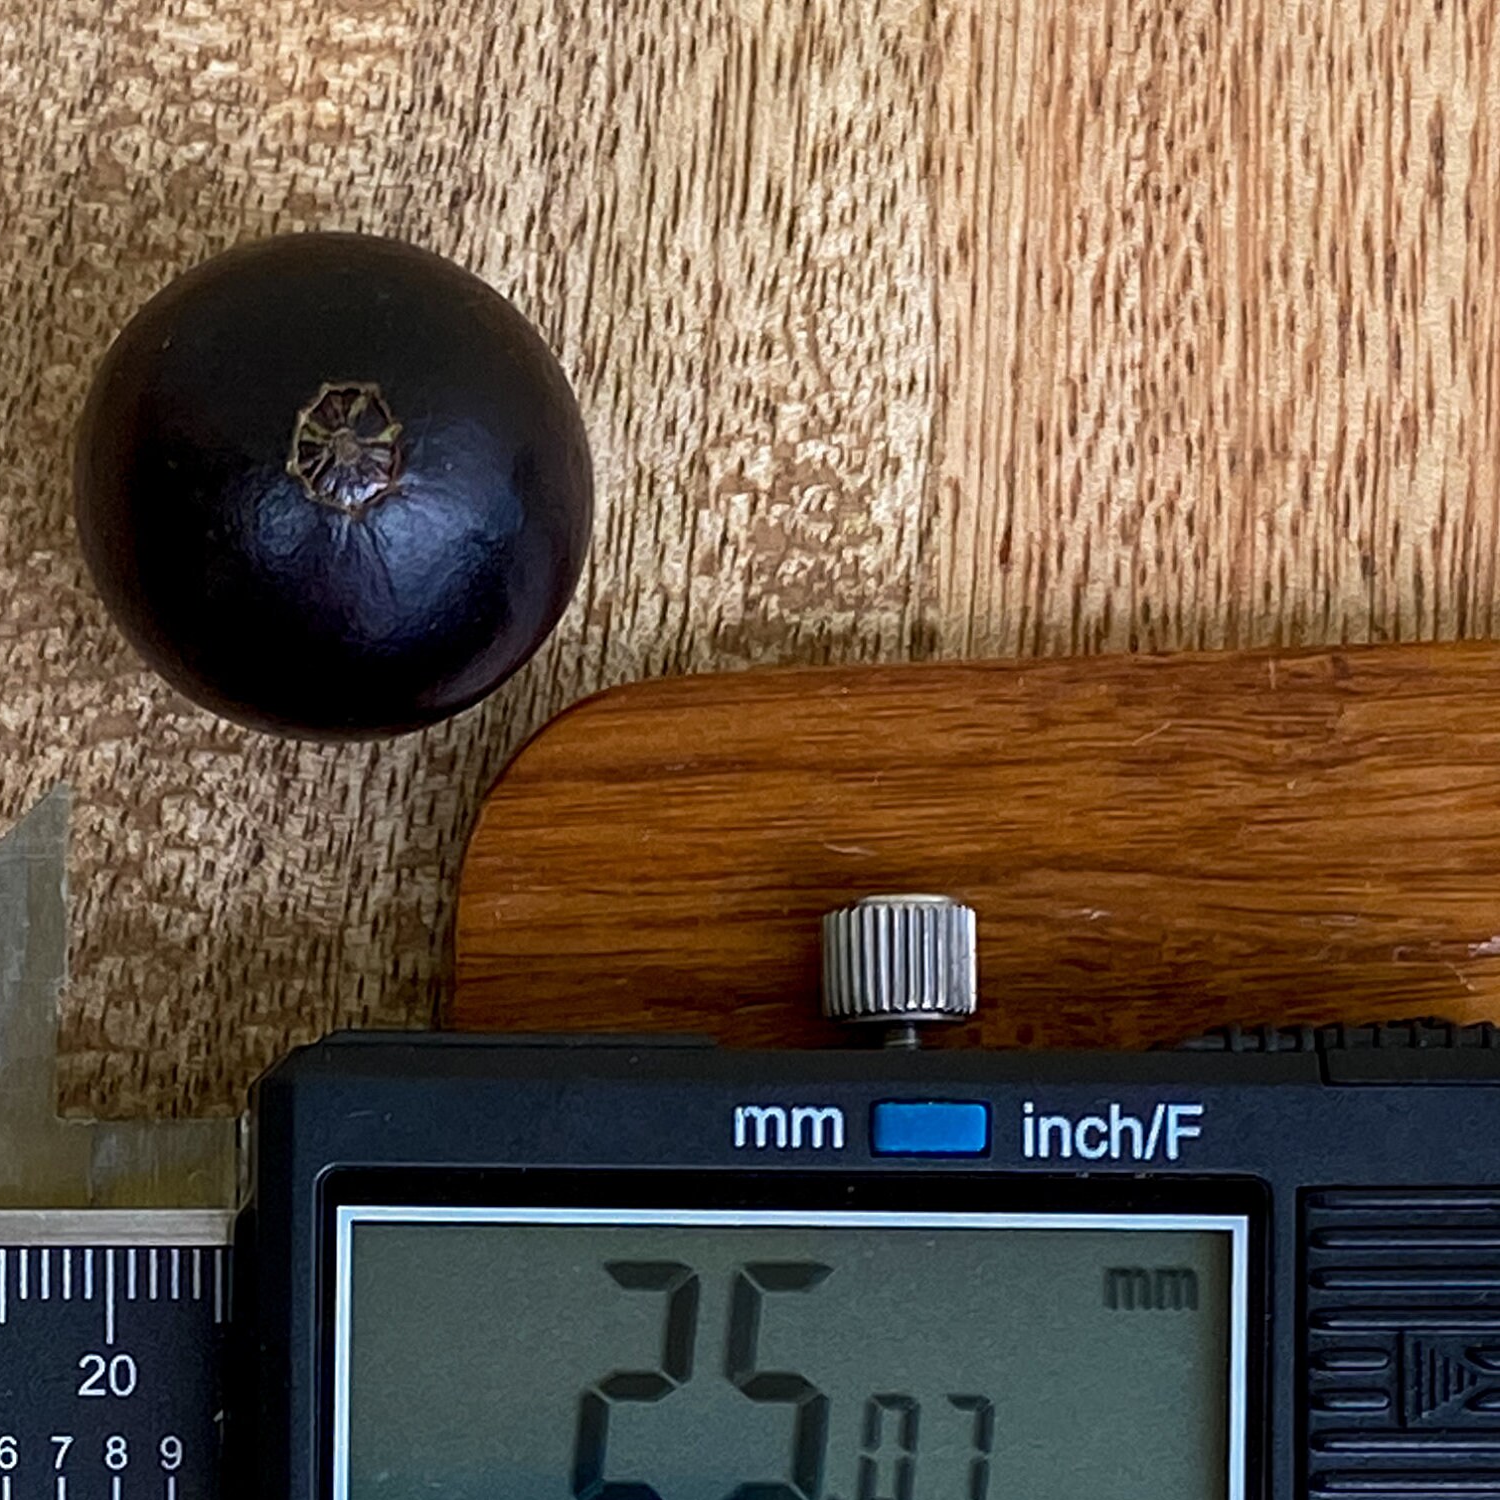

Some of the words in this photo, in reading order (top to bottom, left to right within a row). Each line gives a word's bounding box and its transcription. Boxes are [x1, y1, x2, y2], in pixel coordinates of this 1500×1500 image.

[733, 1104, 845, 1149] mm
[1021, 1102, 1205, 1161] inch/F
[1103, 1266, 1198, 1313] mm
[77, 1353, 137, 1397] 20
[50, 1436, 74, 1470] 7
[105, 1436, 128, 1470] 8
[159, 1436, 183, 1470] 9
